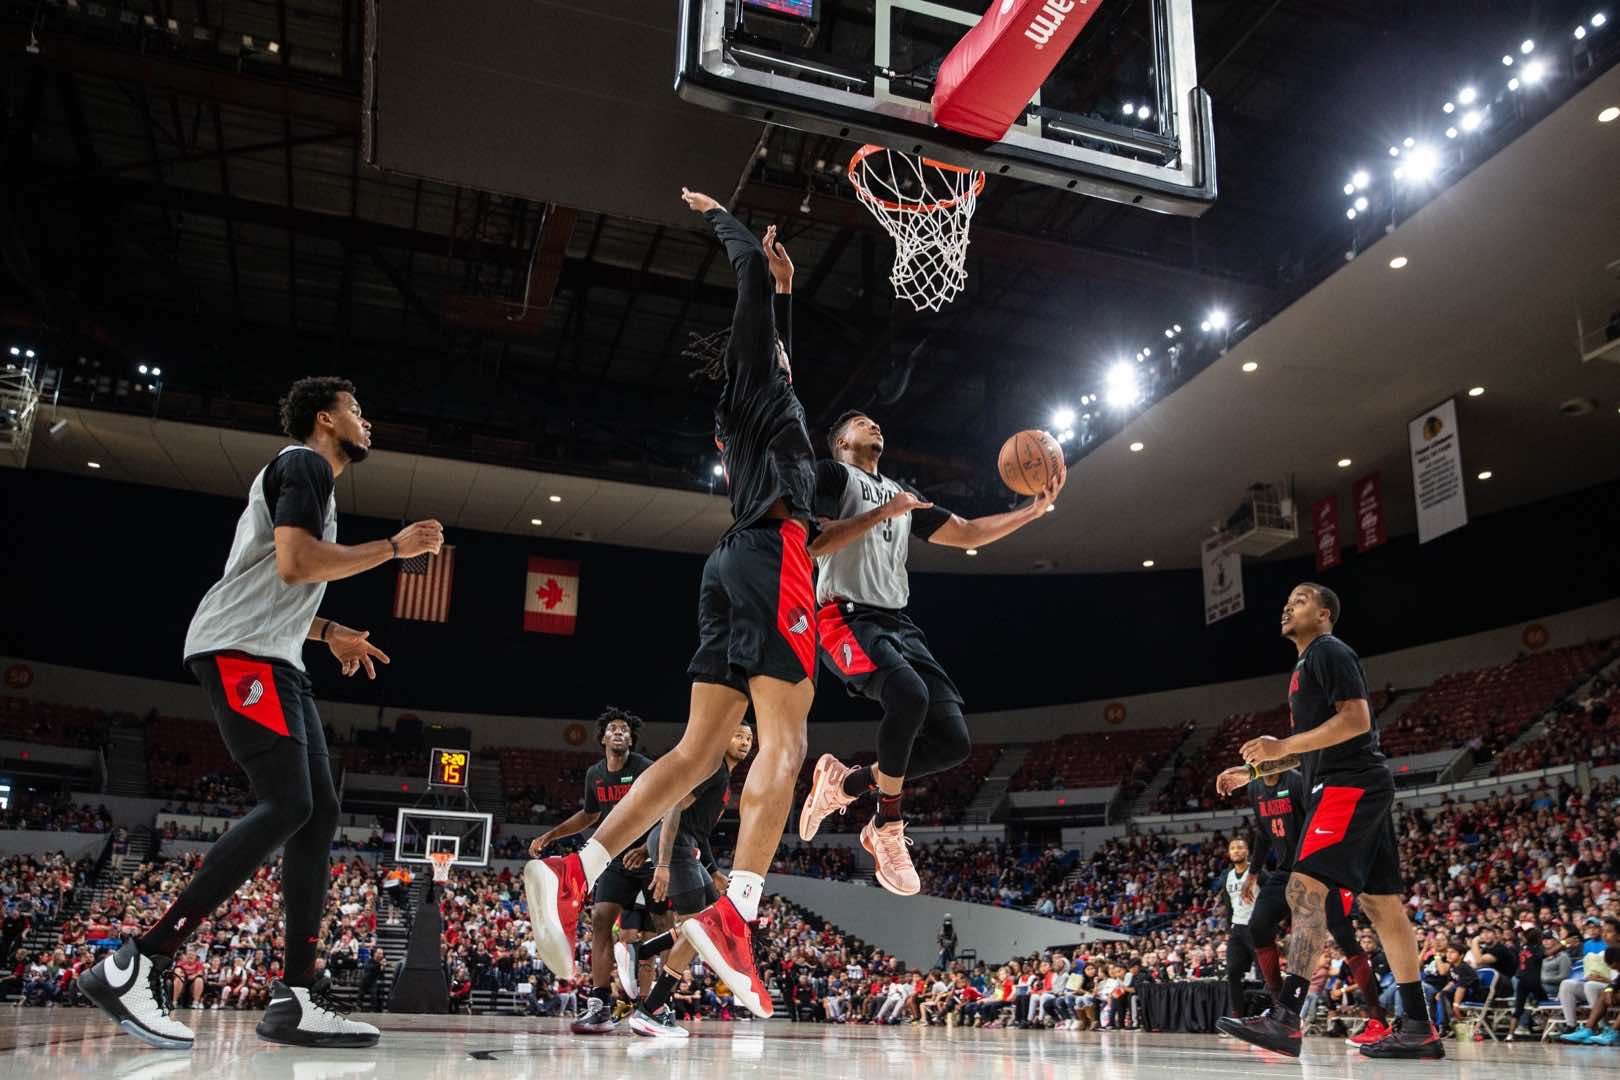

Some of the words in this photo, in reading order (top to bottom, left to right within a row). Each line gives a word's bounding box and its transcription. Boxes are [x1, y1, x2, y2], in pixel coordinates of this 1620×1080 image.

[1024, 0, 1088, 44] arm
[861, 480, 899, 507] BLAZ
[441, 752, 465, 766] 2:20
[444, 765, 459, 783] 15
[1271, 818, 1285, 838] 43
